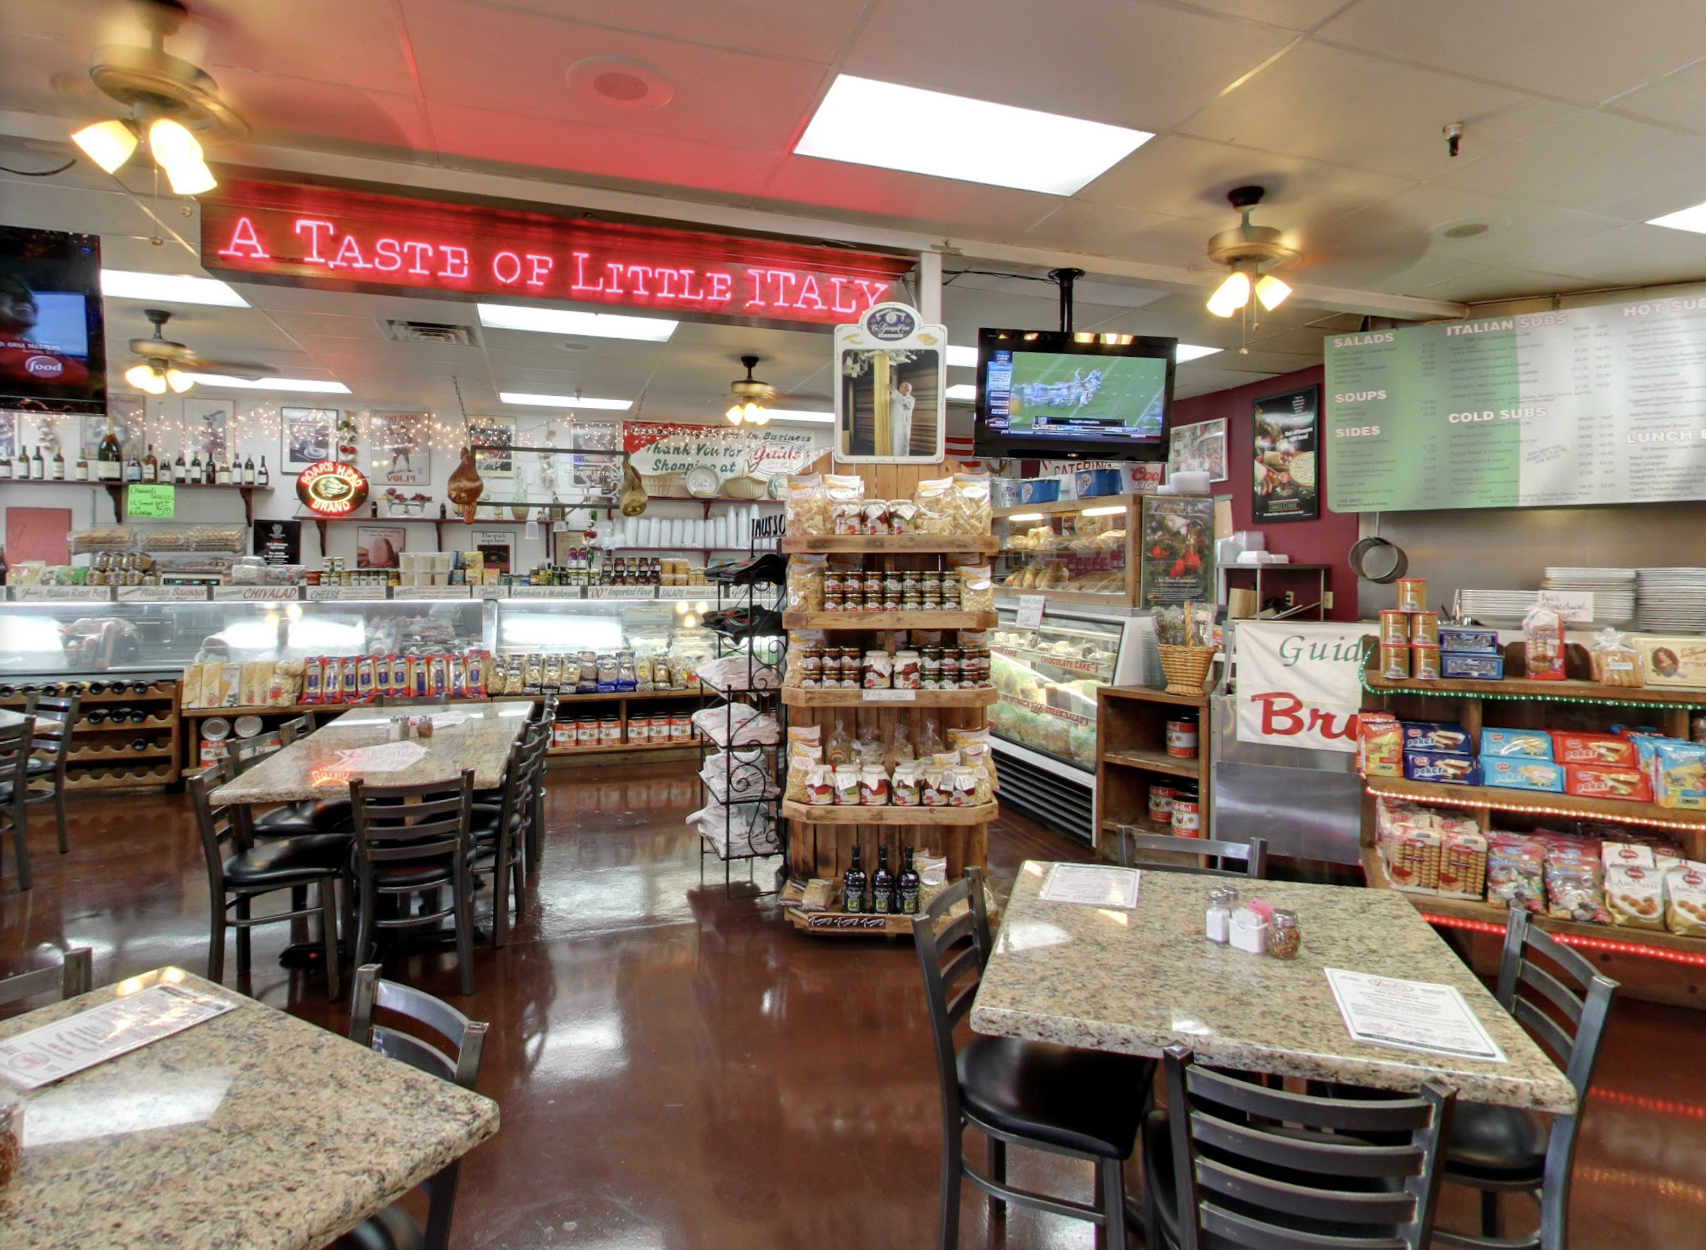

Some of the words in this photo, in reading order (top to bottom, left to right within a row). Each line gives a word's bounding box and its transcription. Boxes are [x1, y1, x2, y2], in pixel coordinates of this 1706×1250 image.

[219, 217, 270, 258] A
[295, 219, 469, 278] TASTE
[493, 251, 553, 286] OF
[572, 252, 732, 301] LITTLE
[744, 268, 889, 315] ITALY
[1624, 303, 1663, 317] HOT
[1446, 319, 1513, 336] ITALIAN
[1520, 314, 1568, 329] SUBS
[1333, 332, 1394, 348] SALADS
[29, 360, 62, 373] food
[1335, 390, 1387, 403] SOUPS
[1448, 411, 1495, 423] COLD
[1499, 407, 1547, 420] SUBS
[763, 432, 811, 442] Business
[1335, 426, 1381, 438] SIDES
[1627, 430, 1693, 444] LUNCH
[646, 442, 692, 455] Thank
[694, 443, 720, 457] You
[723, 445, 743, 458] for
[720, 461, 737, 473] at
[301, 462, 335, 485] BOAR'S
[337, 464, 363, 488] HEAD
[386, 475, 416, 483] VOLPI
[312, 500, 351, 513] BRAND
[310, 590, 340, 599] CHEESE
[512, 590, 541, 598] Artichokes
[548, 589, 579, 598] Mushrooms
[661, 589, 683, 597] SALADS
[1041, 656, 1073, 668] CHOCOLATE
[1074, 660, 1091, 672] CAKE
[1407, 738, 1436, 747] poker
[1566, 750, 1599, 760] poker
[1414, 766, 1443, 777] poker
[1577, 782, 1609, 793] poker
